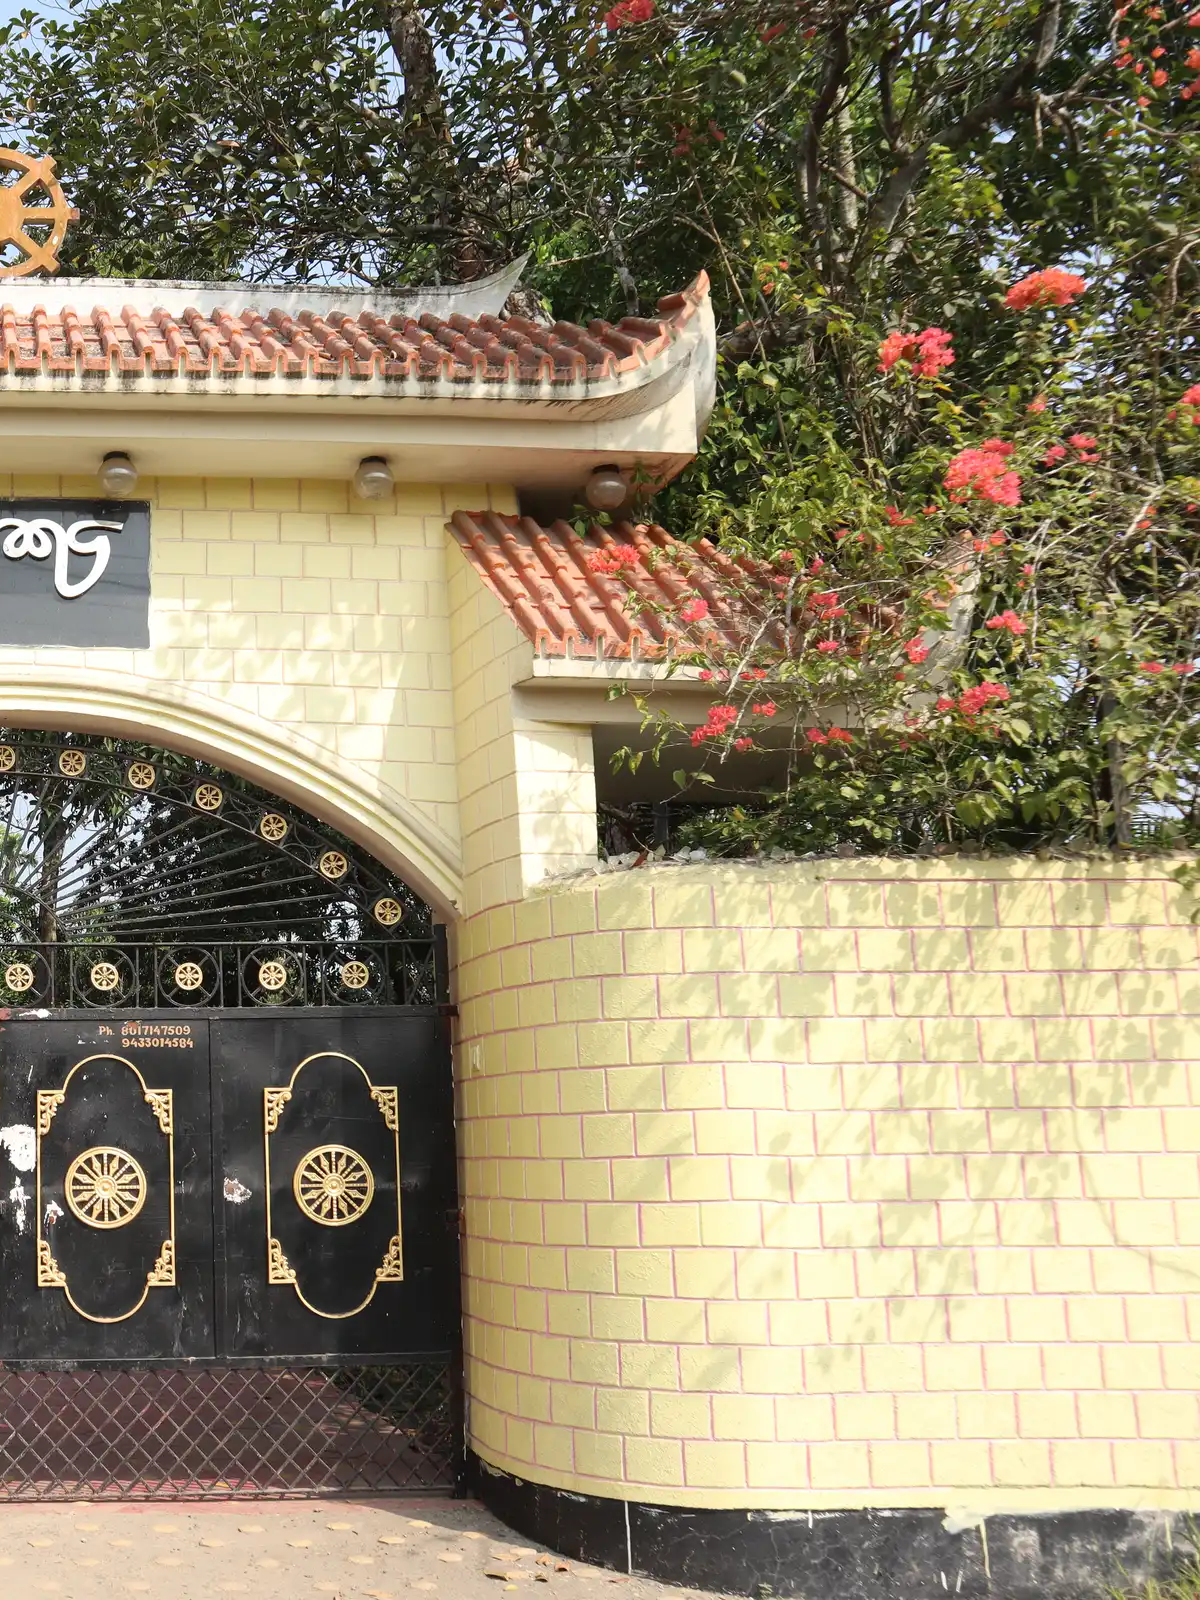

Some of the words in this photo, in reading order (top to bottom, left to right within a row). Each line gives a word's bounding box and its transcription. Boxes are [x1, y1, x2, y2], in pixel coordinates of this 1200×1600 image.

[99, 1026, 115, 1036] Ph.
[121, 1026, 191, 1036] 8017147509
[122, 1038, 194, 1049] 9433014584
